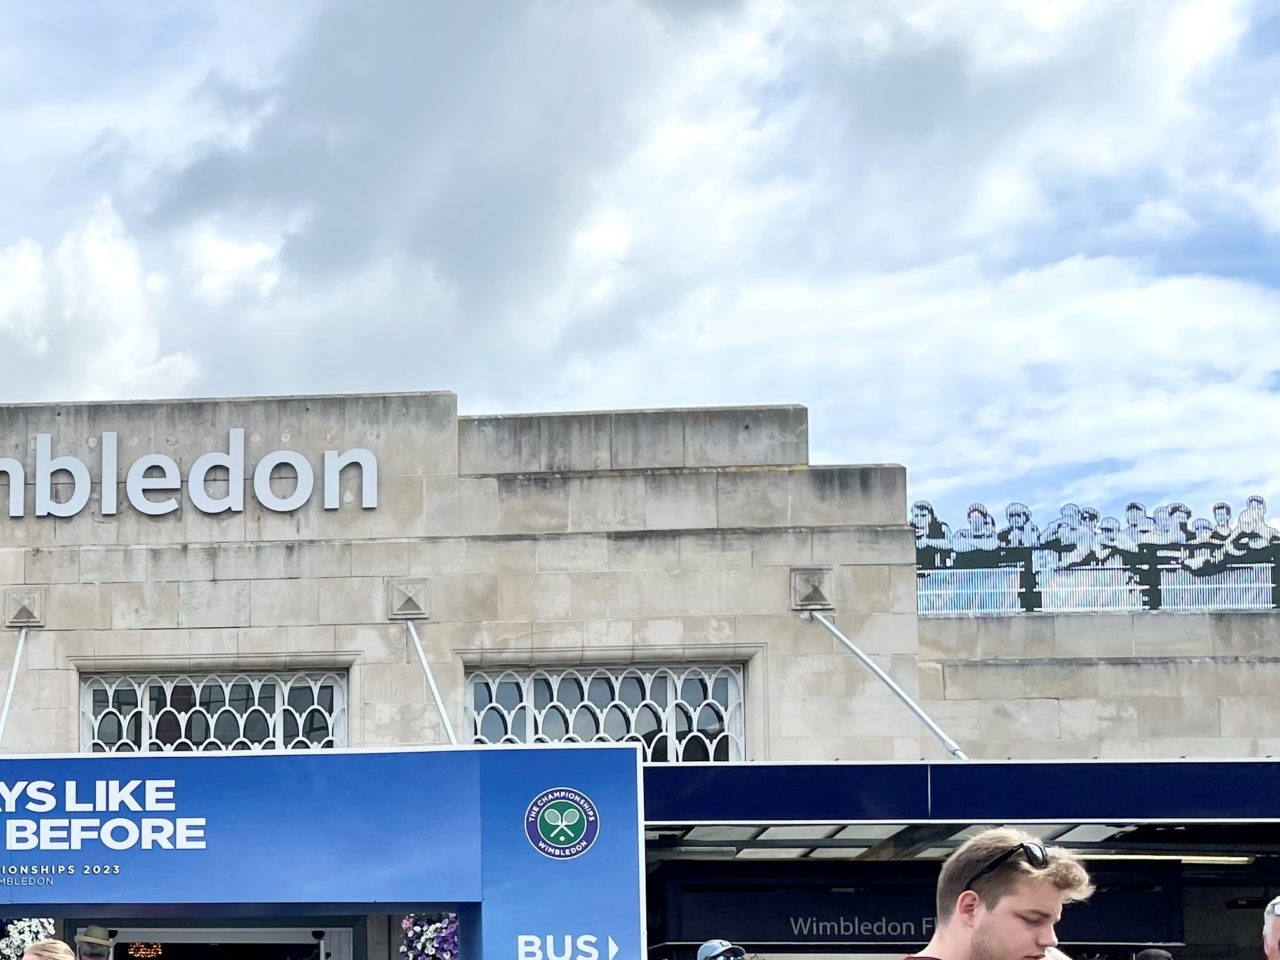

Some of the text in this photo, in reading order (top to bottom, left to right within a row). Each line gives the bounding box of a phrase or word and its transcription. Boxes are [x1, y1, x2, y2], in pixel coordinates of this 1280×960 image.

[65, 779, 176, 812] LIKE
[528, 791, 595, 822] THE CHAMPIONSHIPS
[6, 817, 207, 850] BEFORE
[538, 839, 588, 856] WIMBLEDON
[83, 864, 120, 875] 2023
[790, 916, 915, 936] Wimbledon
